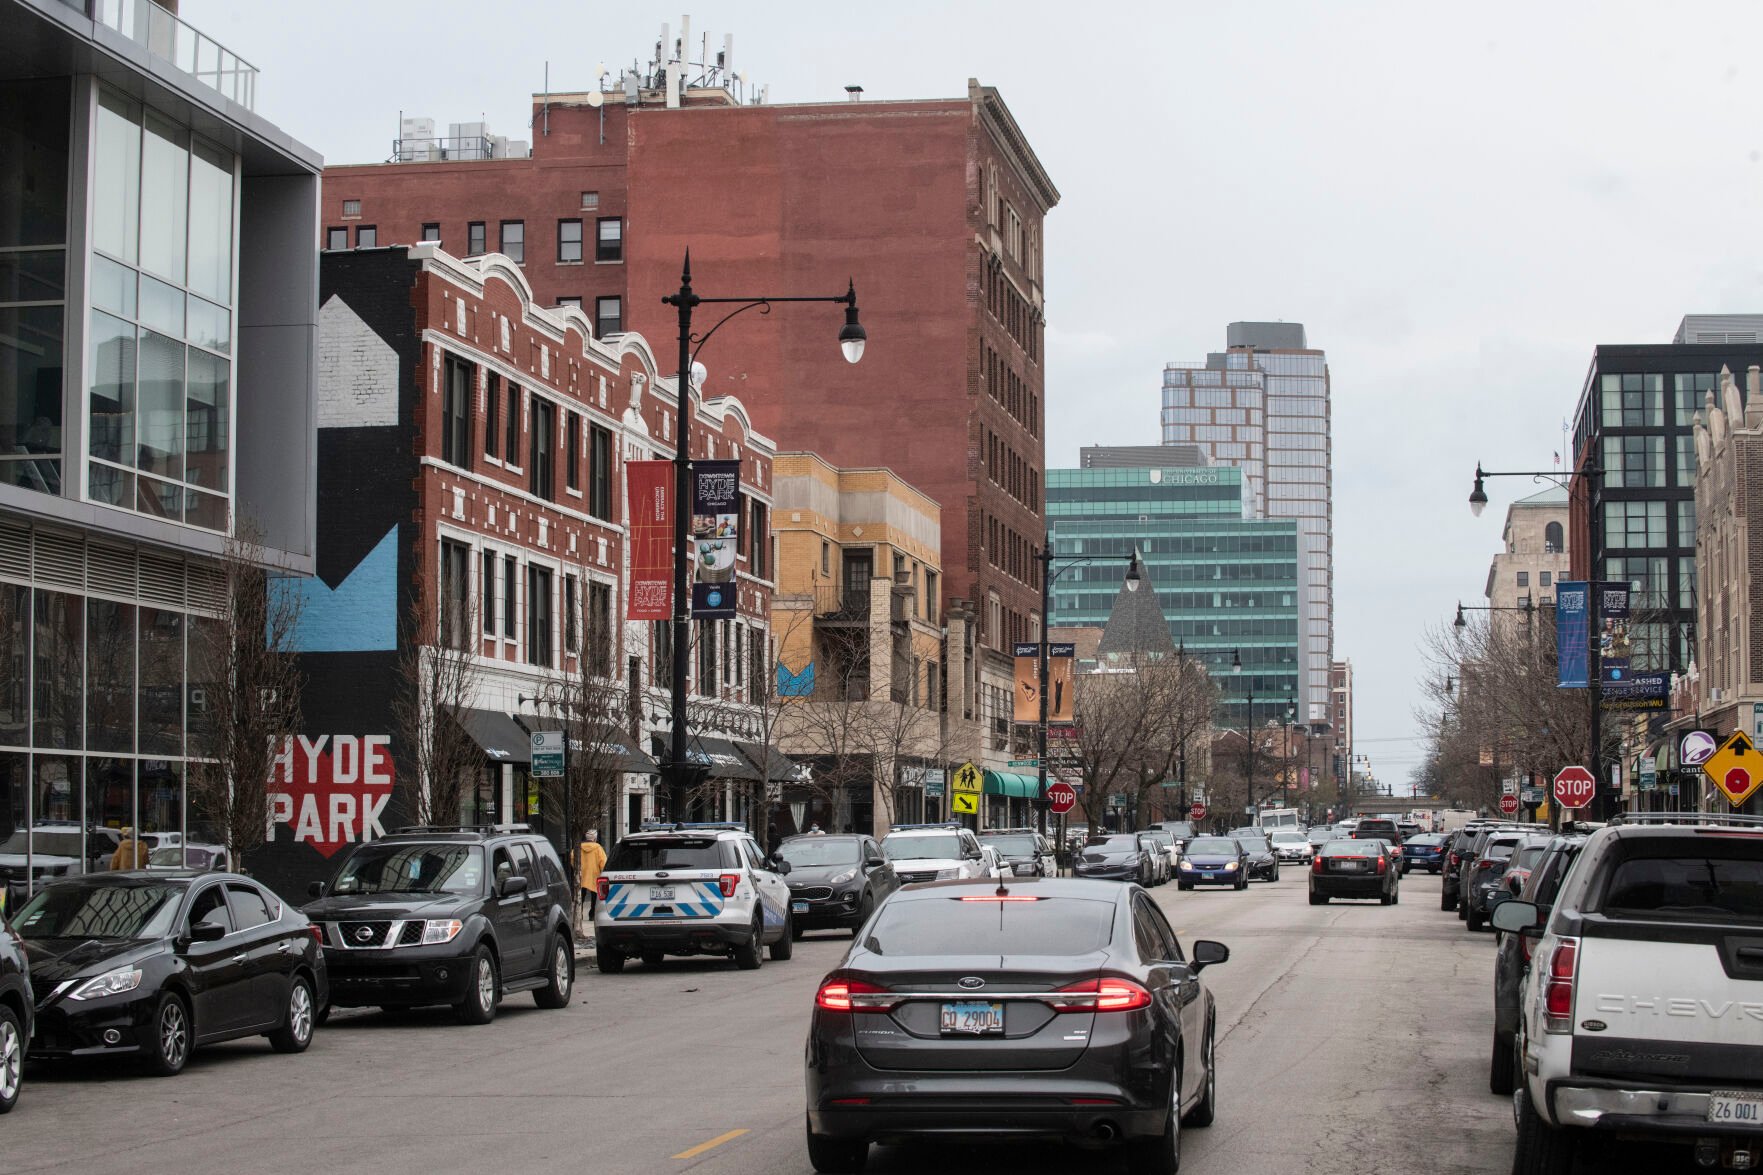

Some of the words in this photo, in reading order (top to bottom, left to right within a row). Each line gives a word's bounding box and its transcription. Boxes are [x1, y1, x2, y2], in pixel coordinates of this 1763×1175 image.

[1163, 474, 1217, 484] CHICAGO
[698, 479, 735, 490] HYDE
[698, 490, 735, 500] PARK
[634, 586, 667, 596] HYDE
[633, 595, 667, 607] PARK
[1560, 601, 1584, 609] PARK
[1603, 601, 1627, 609] PARK
[1631, 677, 1663, 686] CASHED
[265, 734, 391, 785] HYDE
[1680, 766, 1704, 774] cant
[1556, 779, 1592, 796] STOP
[1048, 791, 1074, 804] STOP
[1501, 800, 1518, 808] STOP
[1190, 807, 1205, 815] STOP
[265, 792, 391, 843] PARK
[963, 1010, 1000, 1028] 29004
[1715, 1102, 1731, 1119] 26
[1735, 1103, 1758, 1120] 001
